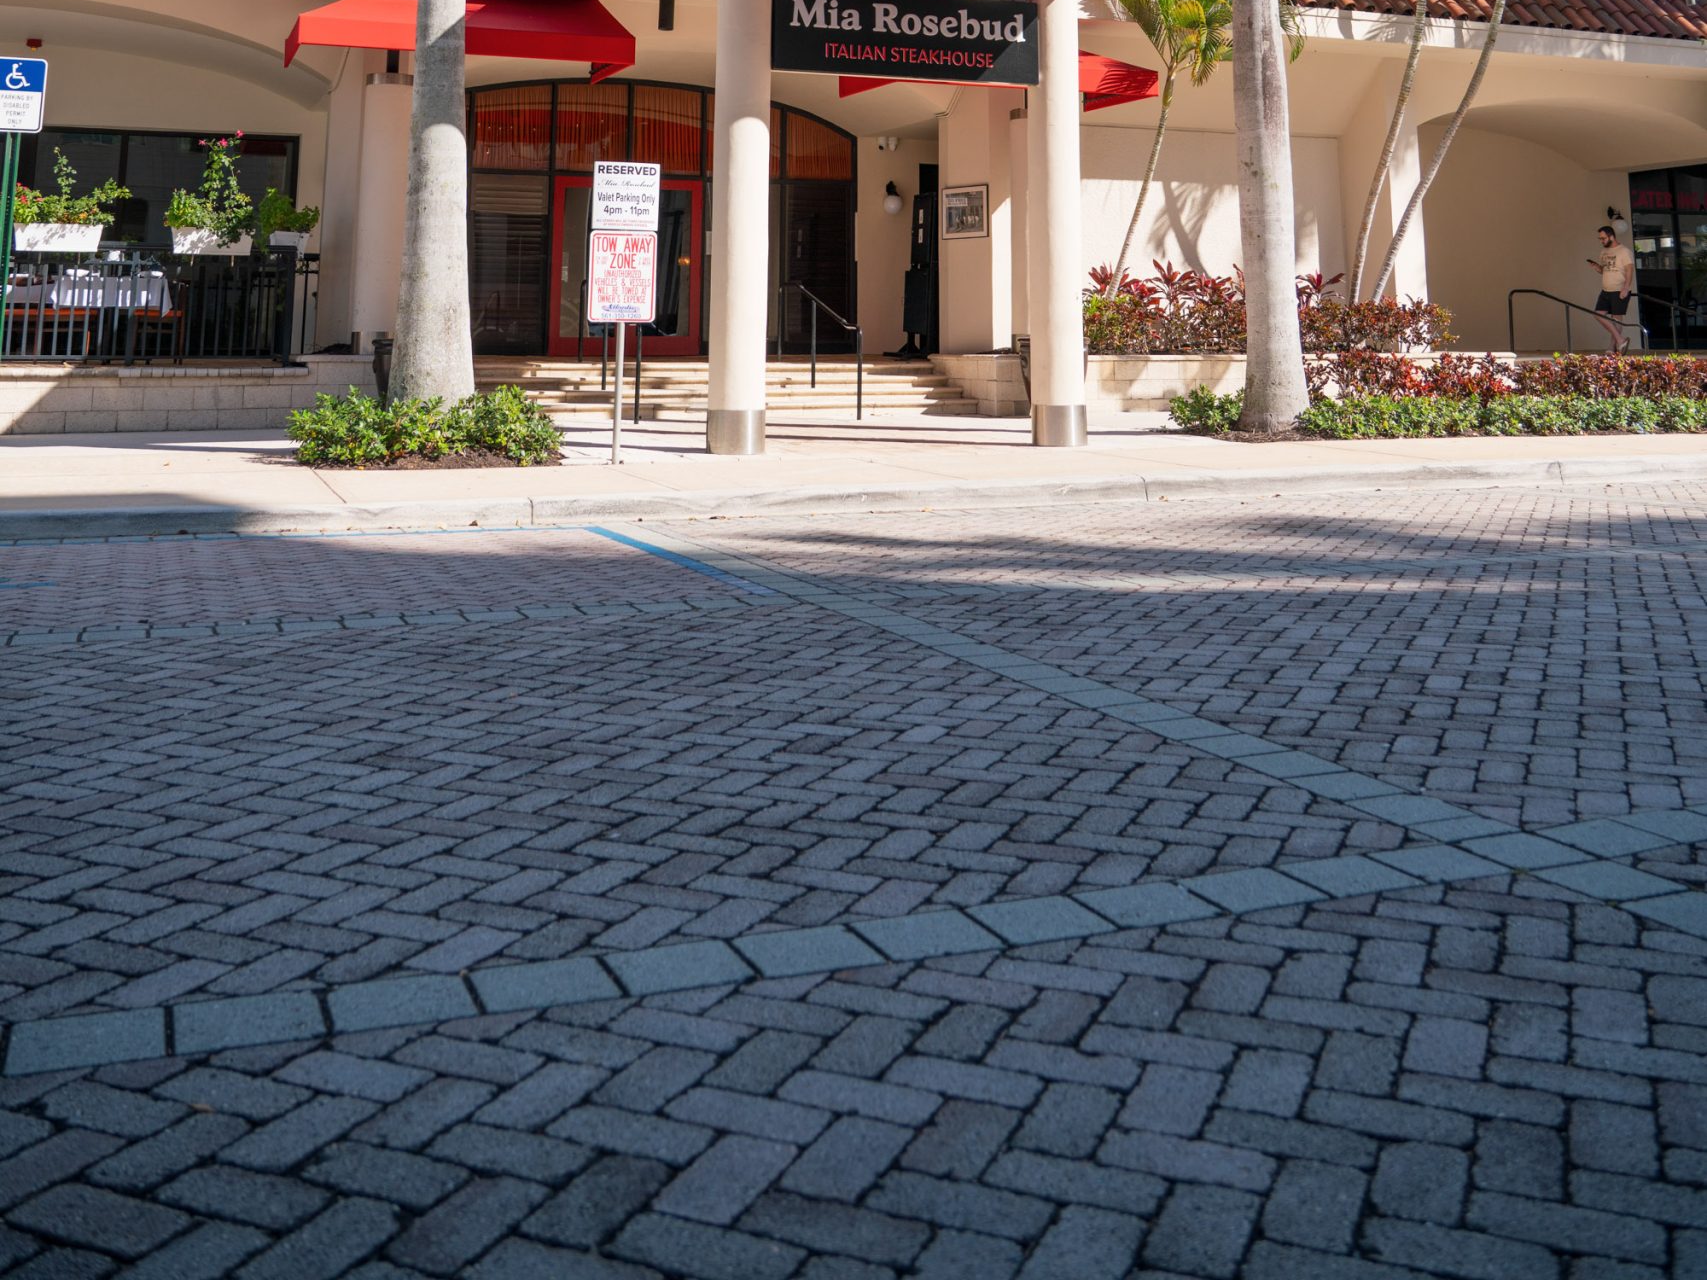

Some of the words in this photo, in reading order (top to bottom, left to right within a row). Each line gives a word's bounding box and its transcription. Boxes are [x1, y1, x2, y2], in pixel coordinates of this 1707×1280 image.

[872, 3, 1026, 43] Rosebud
[824, 42, 887, 62] ITALIAN
[890, 47, 995, 69] STEAKHOUSE
[598, 165, 657, 176] RESERVED
[597, 192, 615, 202] Valet
[616, 192, 640, 205] Parking
[641, 193, 656, 206] Only
[603, 205, 622, 215] 4pm
[629, 206, 650, 216] 11pm
[596, 236, 618, 252] TOW
[623, 237, 653, 254] AWAY
[609, 253, 637, 269] ZONE
